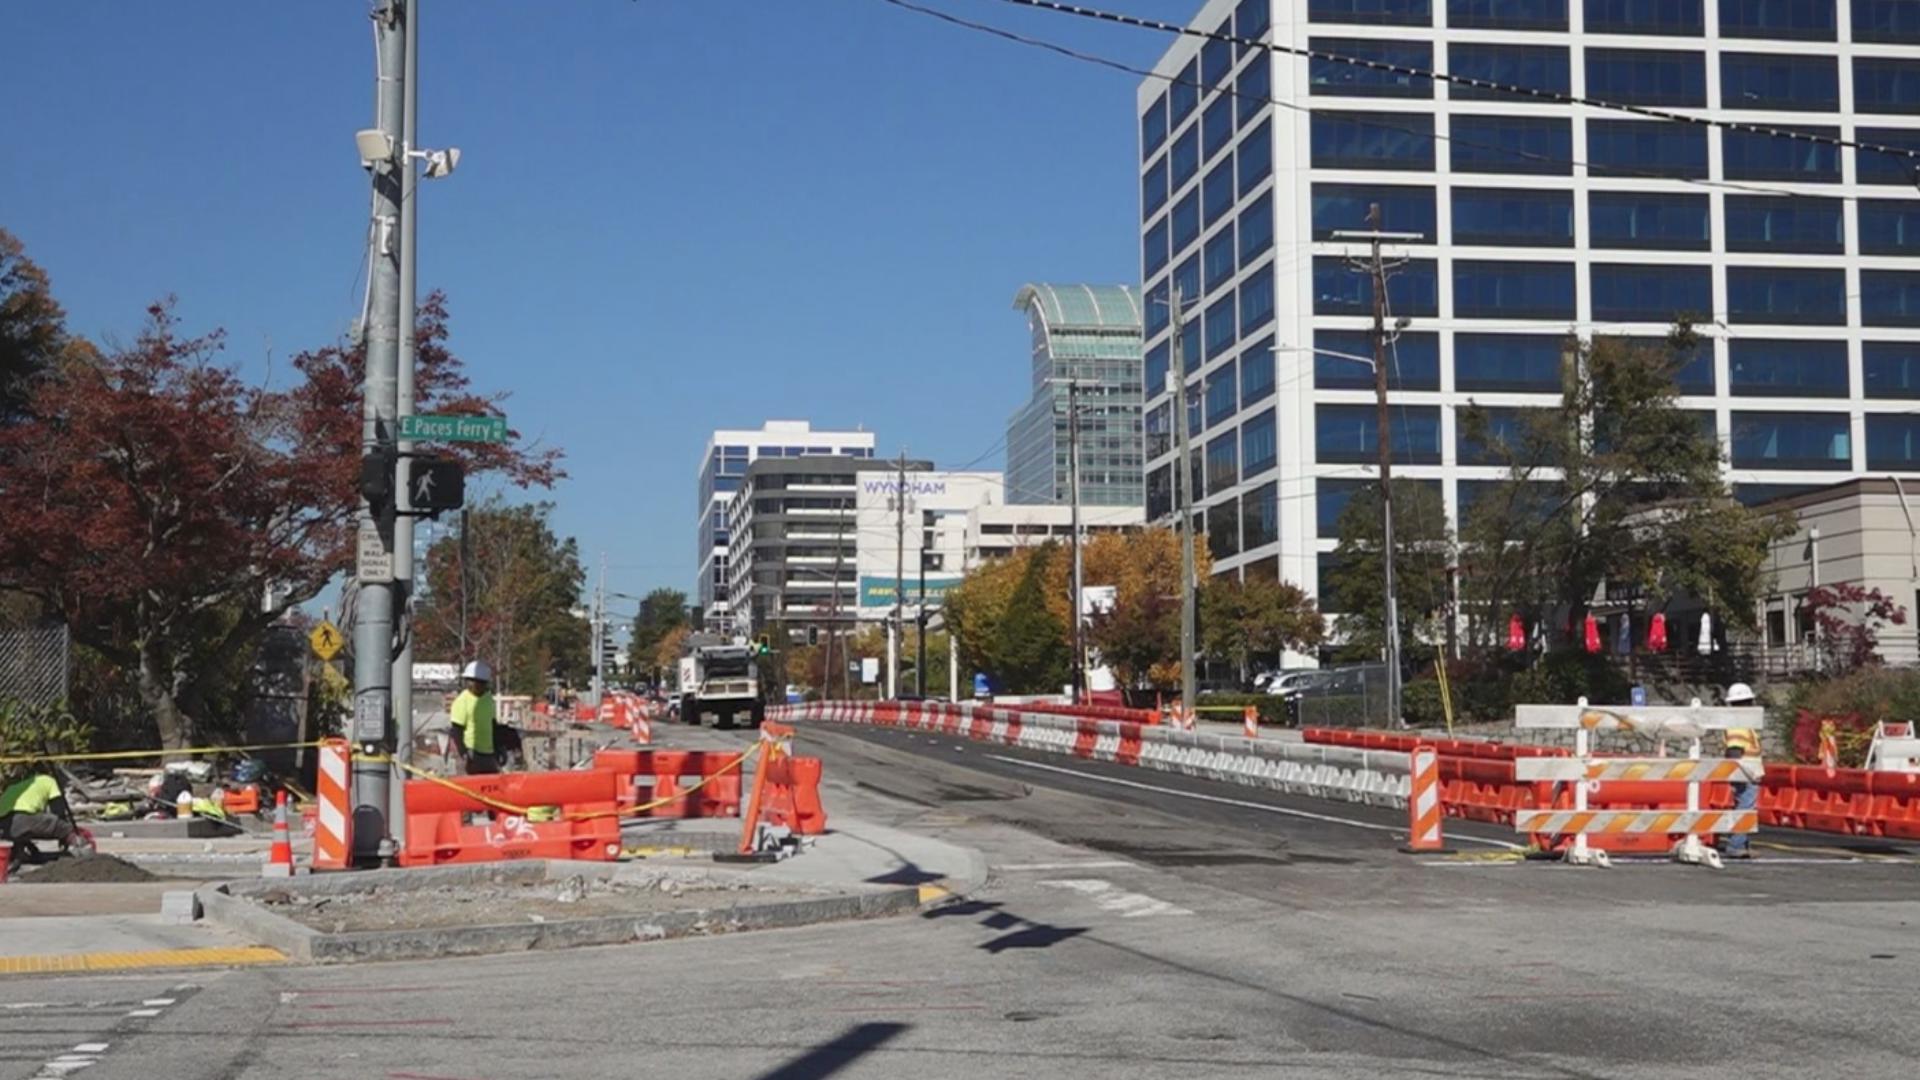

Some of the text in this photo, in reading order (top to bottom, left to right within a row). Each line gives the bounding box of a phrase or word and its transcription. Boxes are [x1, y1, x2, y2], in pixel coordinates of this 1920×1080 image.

[402, 418, 490, 440] E Paces Ferry
[864, 481, 946, 495] WYNDHAM
